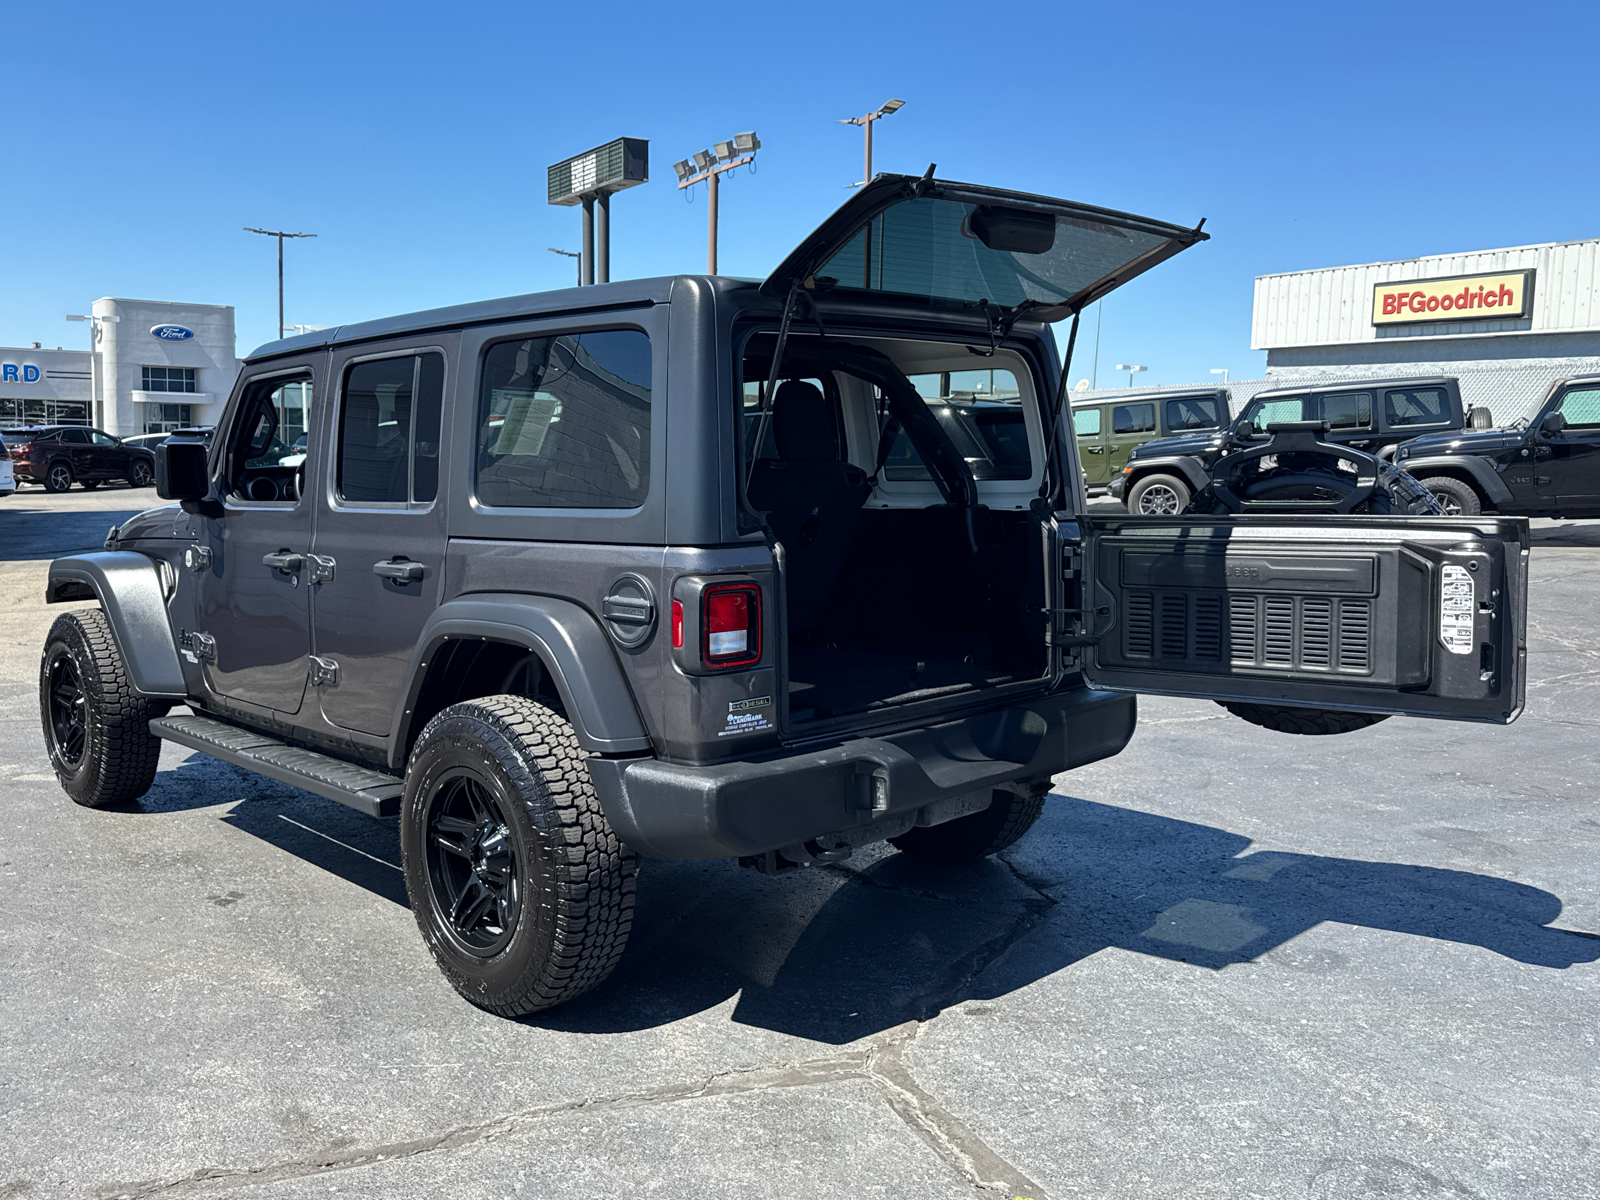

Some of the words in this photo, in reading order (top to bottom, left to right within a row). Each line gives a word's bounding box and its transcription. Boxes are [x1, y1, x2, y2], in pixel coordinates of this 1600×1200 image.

[1382, 283, 1514, 315] BFGoodrich
[160, 327, 186, 339] Ford
[2, 363, 42, 383] RD
[1226, 564, 1260, 579] Jeep
[733, 714, 762, 724] LANDMARK
